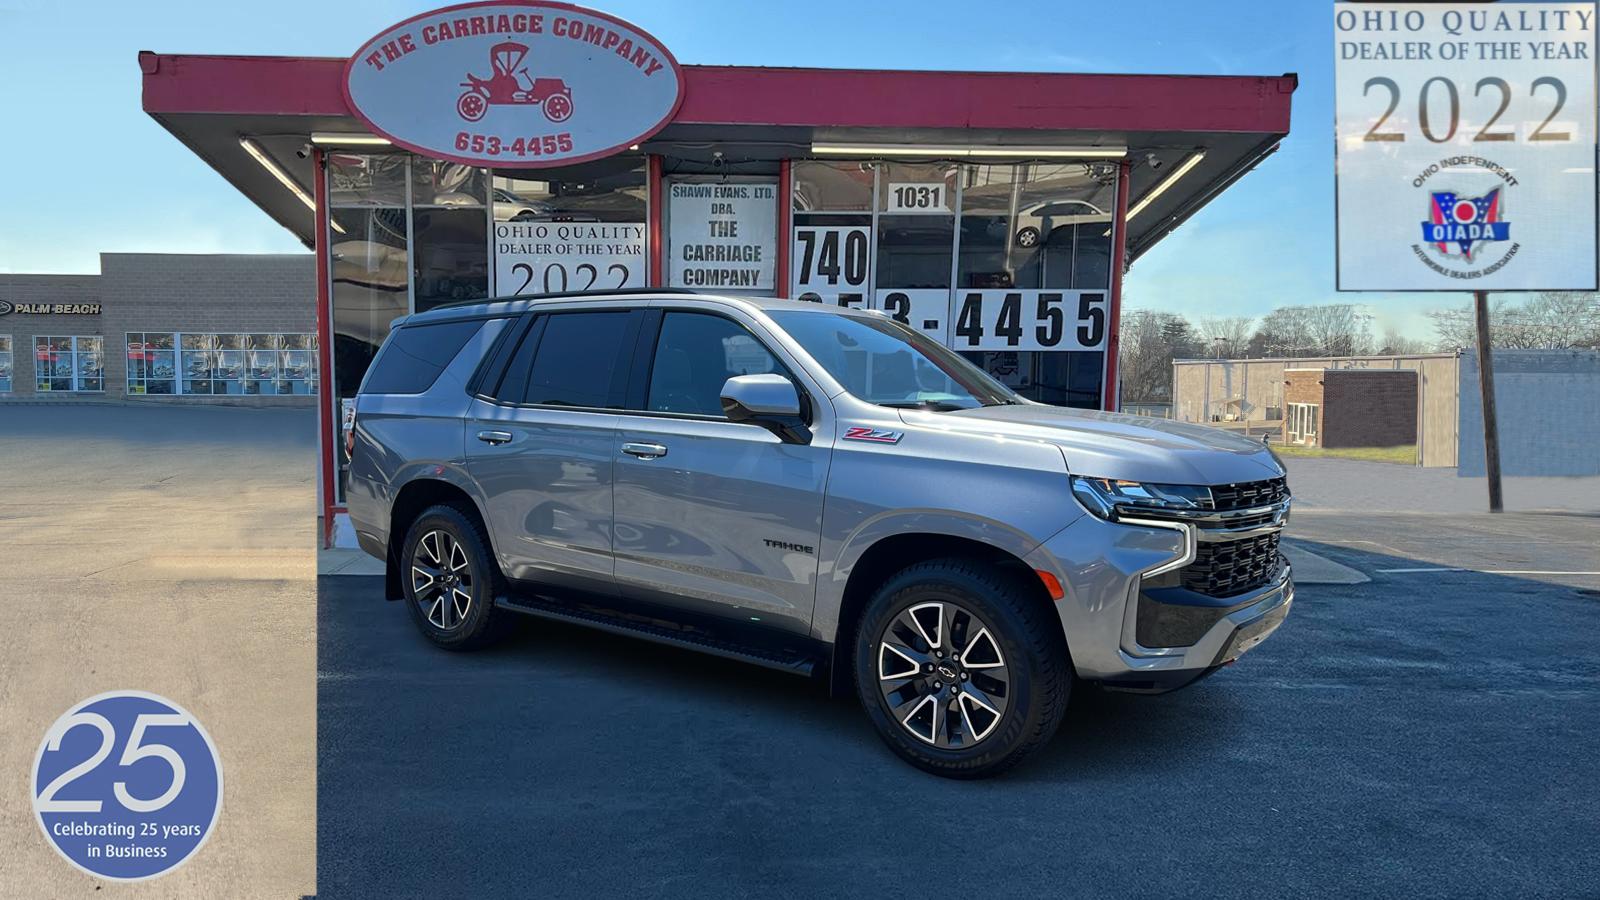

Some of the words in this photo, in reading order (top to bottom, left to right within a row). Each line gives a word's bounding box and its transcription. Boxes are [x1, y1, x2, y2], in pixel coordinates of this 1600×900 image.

[1336, 10, 1425, 31] OHIO
[1442, 10, 1592, 35] QUALITY
[365, 33, 417, 72] THE
[422, 15, 544, 45] CARRIAGE
[552, 17, 664, 77] COMPANY
[1340, 42, 1433, 60] DEALER
[1438, 42, 1469, 60] OF
[1475, 42, 1522, 60] THE
[1528, 42, 1589, 60] YEAR
[1362, 76, 1571, 143] 2022
[454, 132, 573, 155] 653-4455
[1412, 164, 1439, 188] OHIO
[1440, 155, 1519, 187] INDEPENDENT
[672, 186, 712, 199] SHAWN
[754, 187, 775, 199] LTD.
[894, 187, 941, 208] 1031
[711, 203, 736, 215] DBA.
[497, 226, 548, 239] OHIO
[557, 226, 644, 242] QUALITY
[708, 220, 738, 238] THE
[1433, 225, 1495, 240] OIADA
[500, 243, 552, 255] DEALER
[555, 243, 573, 255] OF
[576, 243, 603, 255] THE
[606, 243, 641, 255] YEAR
[682, 244, 762, 262] CARRIAGE
[797, 230, 868, 286] 740
[1411, 243, 1449, 277] AUTOMOBILE
[1449, 269, 1482, 279] DEALERS
[1482, 242, 1520, 276] ASSOCIATION
[511, 262, 630, 296] 2022
[683, 268, 760, 286] COMPANY
[15, 304, 50, 314] PALM
[54, 304, 100, 314] BEACH
[797, 292, 1105, 347] 3-4455
[843, 427, 904, 445] Z71
[763, 539, 813, 554] TAHOE
